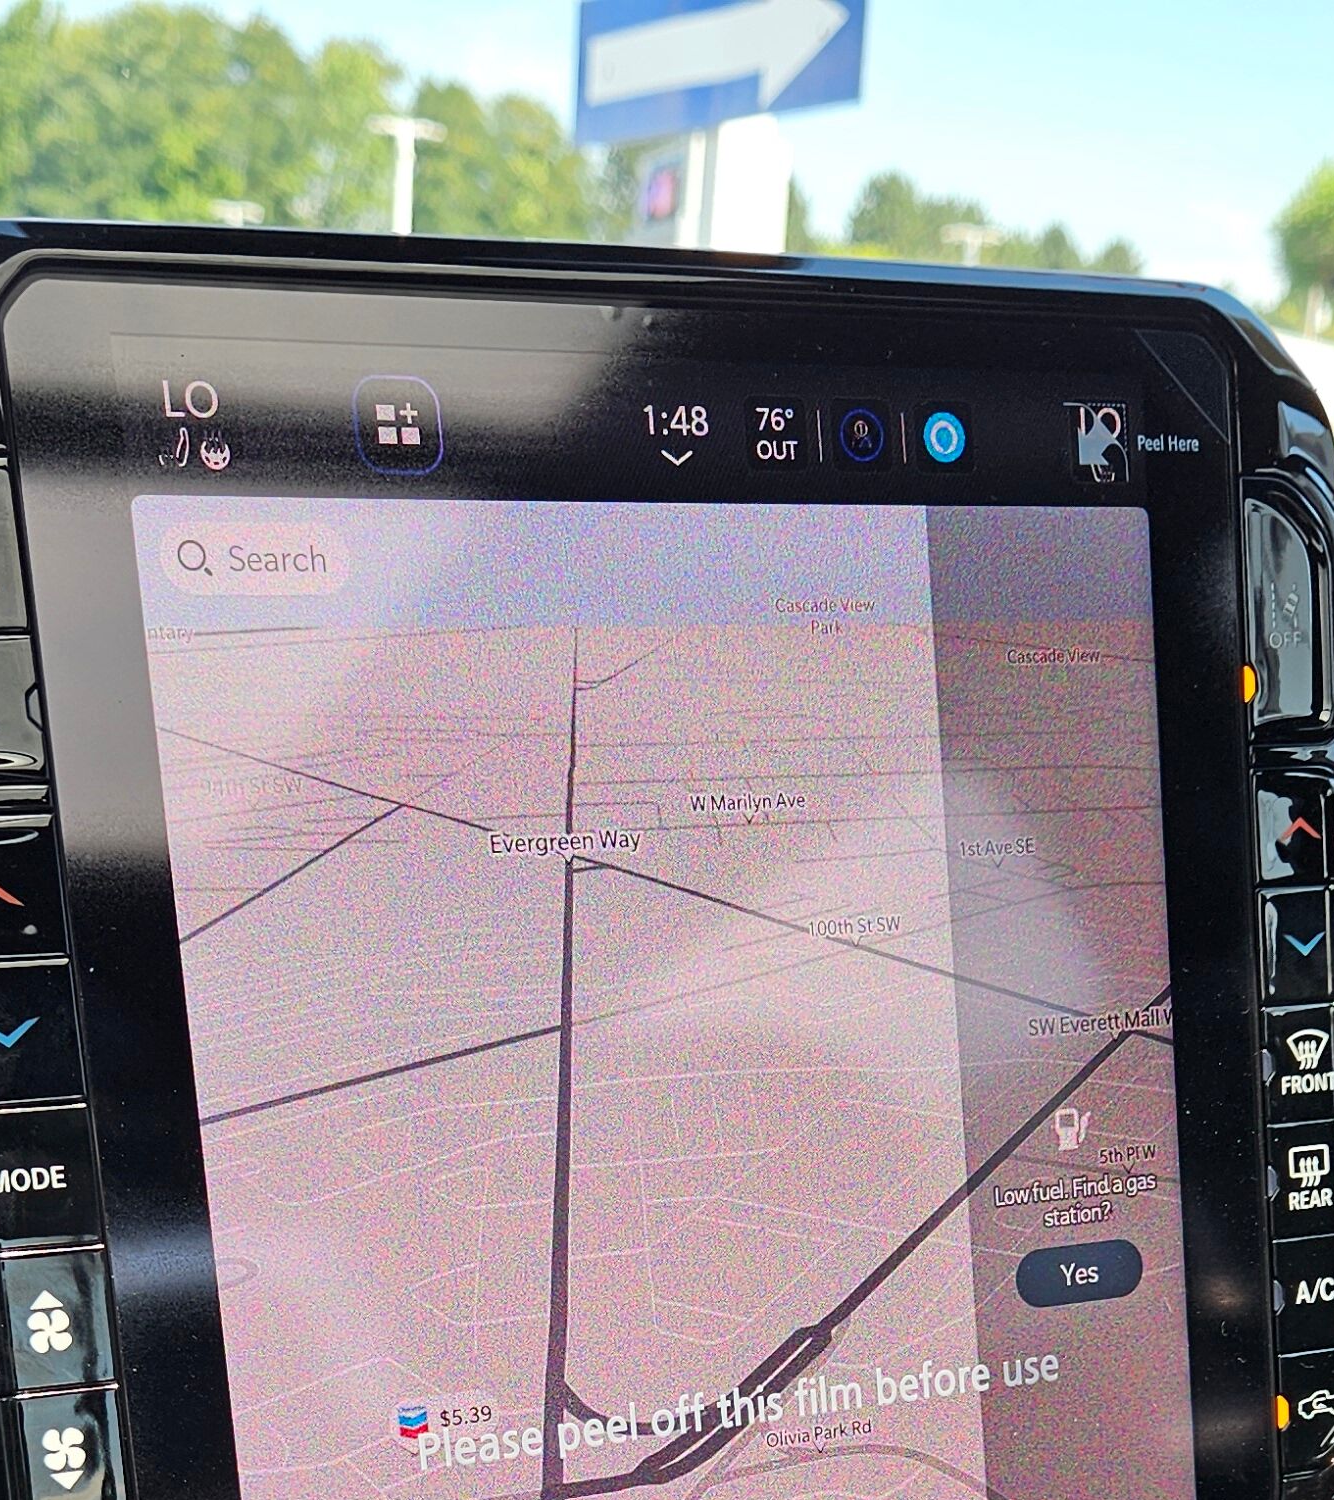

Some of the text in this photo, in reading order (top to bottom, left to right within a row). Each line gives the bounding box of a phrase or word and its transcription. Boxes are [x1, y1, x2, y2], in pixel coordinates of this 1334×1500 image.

[162, 379, 219, 419] LO
[643, 404, 709, 438] 1:48
[756, 439, 798, 461] OUT
[1137, 433, 1200, 452] Peel Here
[228, 543, 327, 574] Search
[775, 598, 875, 614] Cascade View
[811, 620, 843, 636] Park
[1269, 631, 1302, 648] OFF
[1007, 648, 1100, 664] Cascade View
[689, 793, 806, 814] W Marilyn Ave
[490, 830, 641, 855] Evergreen Way
[960, 838, 1035, 856] 1st Ave SE
[809, 916, 901, 937] 100th St SW
[1028, 1018, 1056, 1036] SW
[1060, 1013, 1121, 1034] Everett
[1125, 1008, 1162, 1031] Mall
[1099, 1149, 1123, 1165] 5th
[1142, 1144, 1157, 1159] W
[993, 1174, 1157, 1207] Low fuel. Find a gas
[1288, 1188, 1333, 1211] REAR
[1043, 1202, 1111, 1228] station?
[1060, 1262, 1099, 1287] Yes
[417, 1353, 1060, 1471] Please peel off this film before use
[439, 1404, 493, 1428] $5.39
[766, 1417, 872, 1448] Olivia Park Rd
